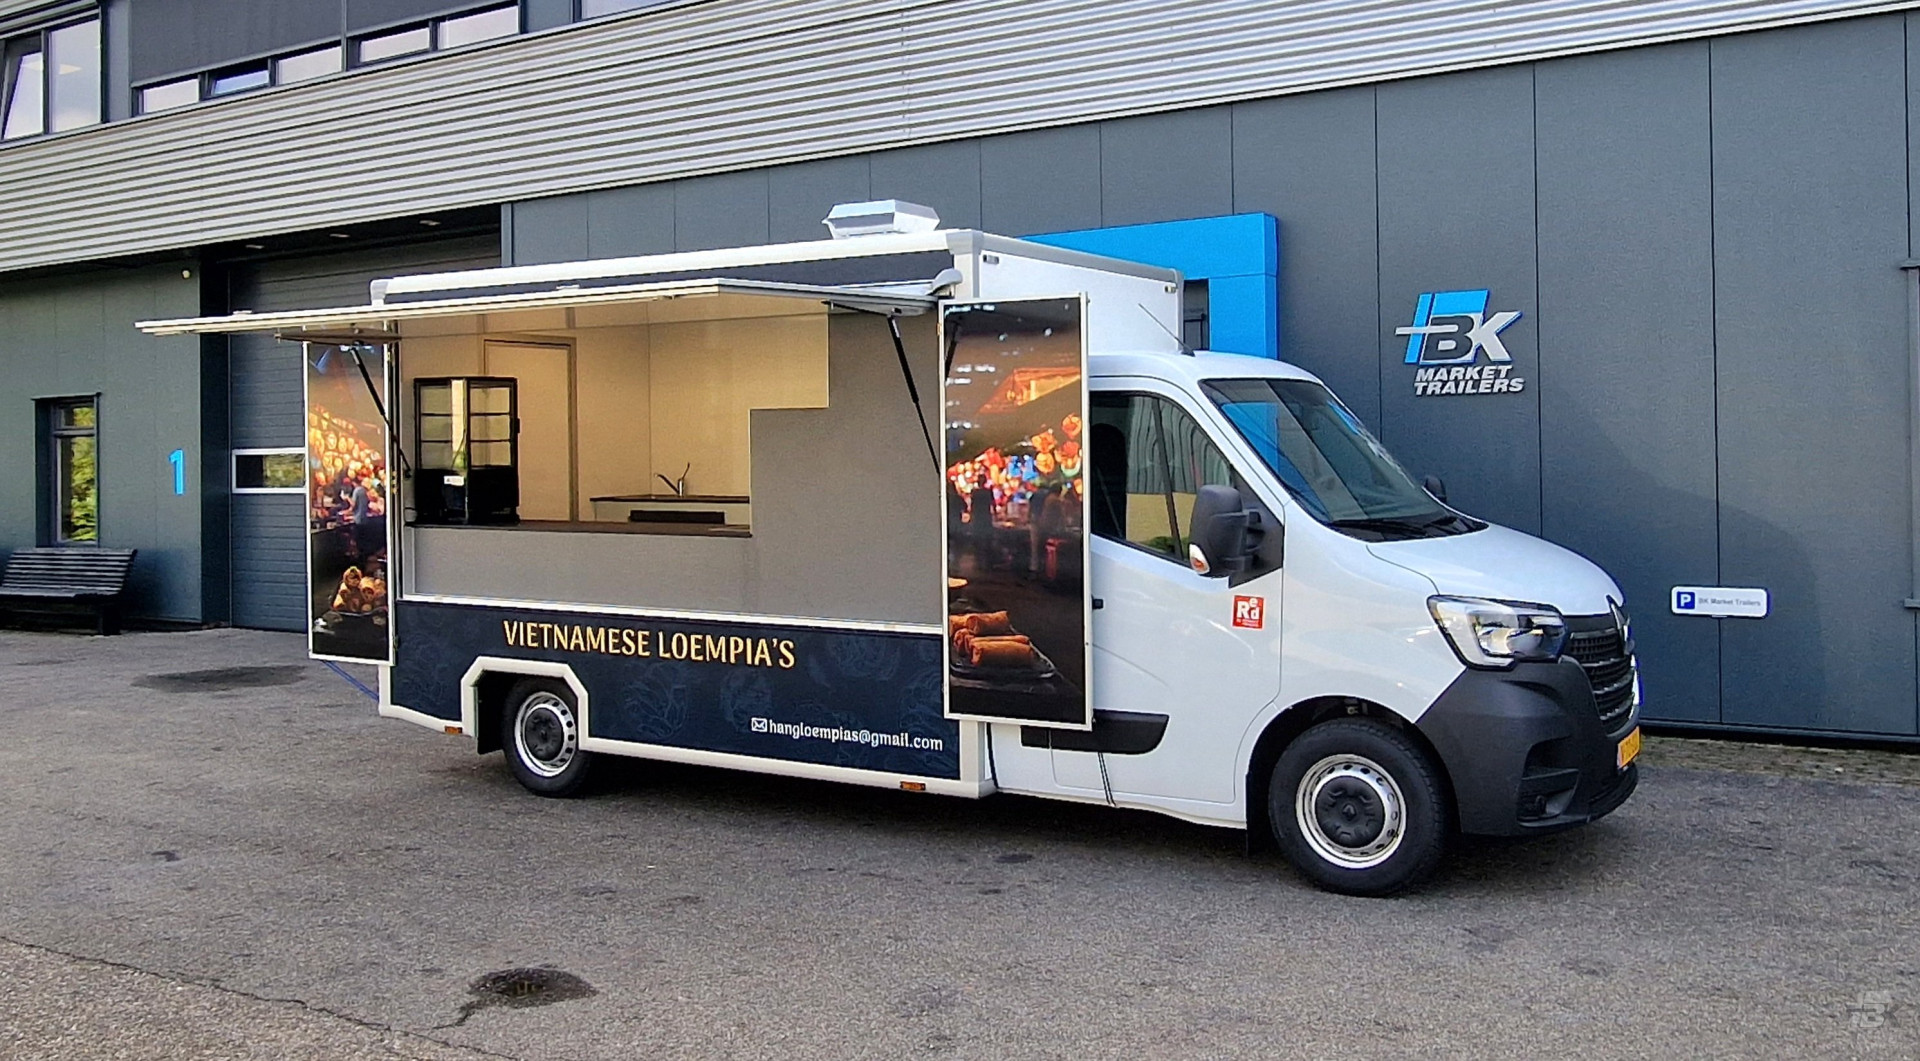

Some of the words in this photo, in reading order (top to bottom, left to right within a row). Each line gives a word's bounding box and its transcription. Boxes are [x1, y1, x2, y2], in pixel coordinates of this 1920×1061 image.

[1418, 311, 1522, 365] BK
[1414, 378, 1524, 396] TRAILERS
[1415, 365, 1512, 382] MARKET
[169, 449, 184, 495] 1
[1711, 597, 1734, 605] Market
[1736, 597, 1761, 607] Trailers
[503, 620, 650, 656] VIETNAMESE
[769, 719, 943, 751] hangloempias@gmail.com
